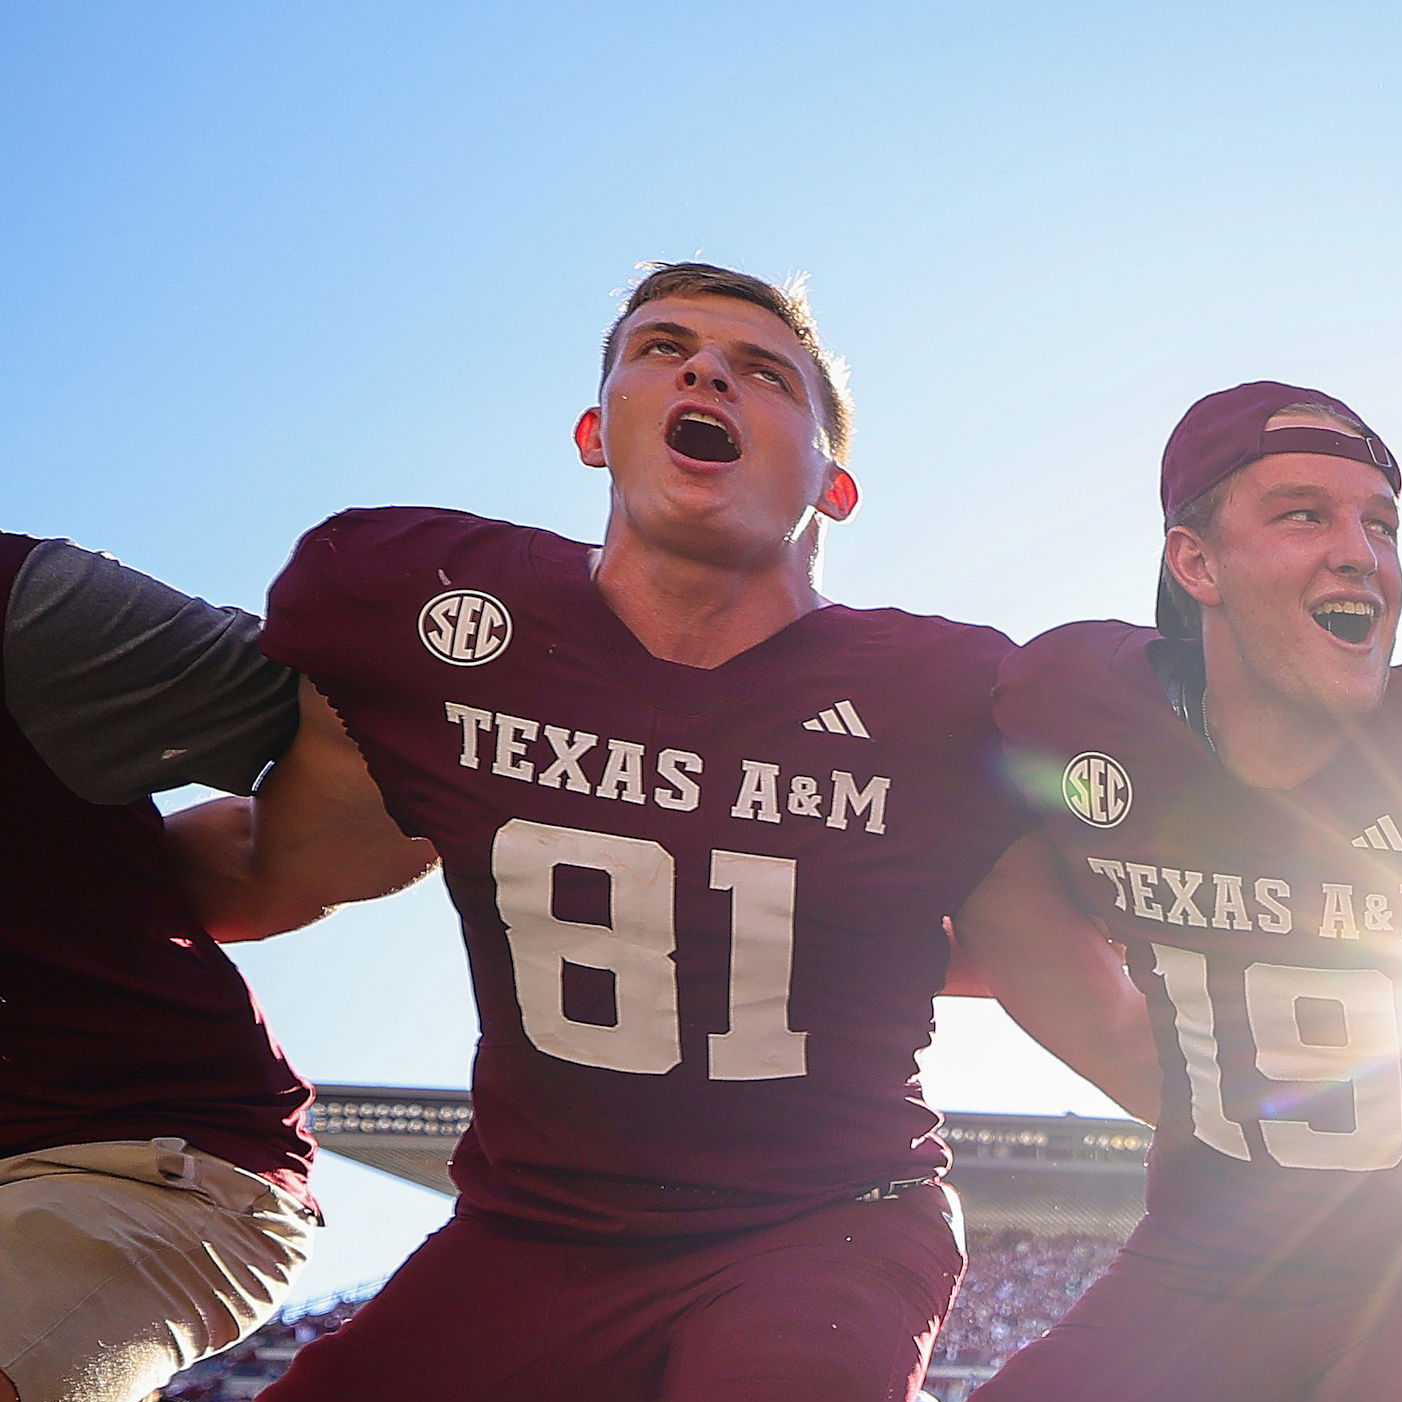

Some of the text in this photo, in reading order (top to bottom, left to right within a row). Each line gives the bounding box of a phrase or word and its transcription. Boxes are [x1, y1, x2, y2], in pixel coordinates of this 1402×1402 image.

[425, 597, 506, 660] SEC
[443, 702, 892, 835] TEXAS A&M
[1068, 757, 1125, 822] SEC
[1087, 857, 1292, 936] TEXAS
[491, 818, 808, 1081] 81
